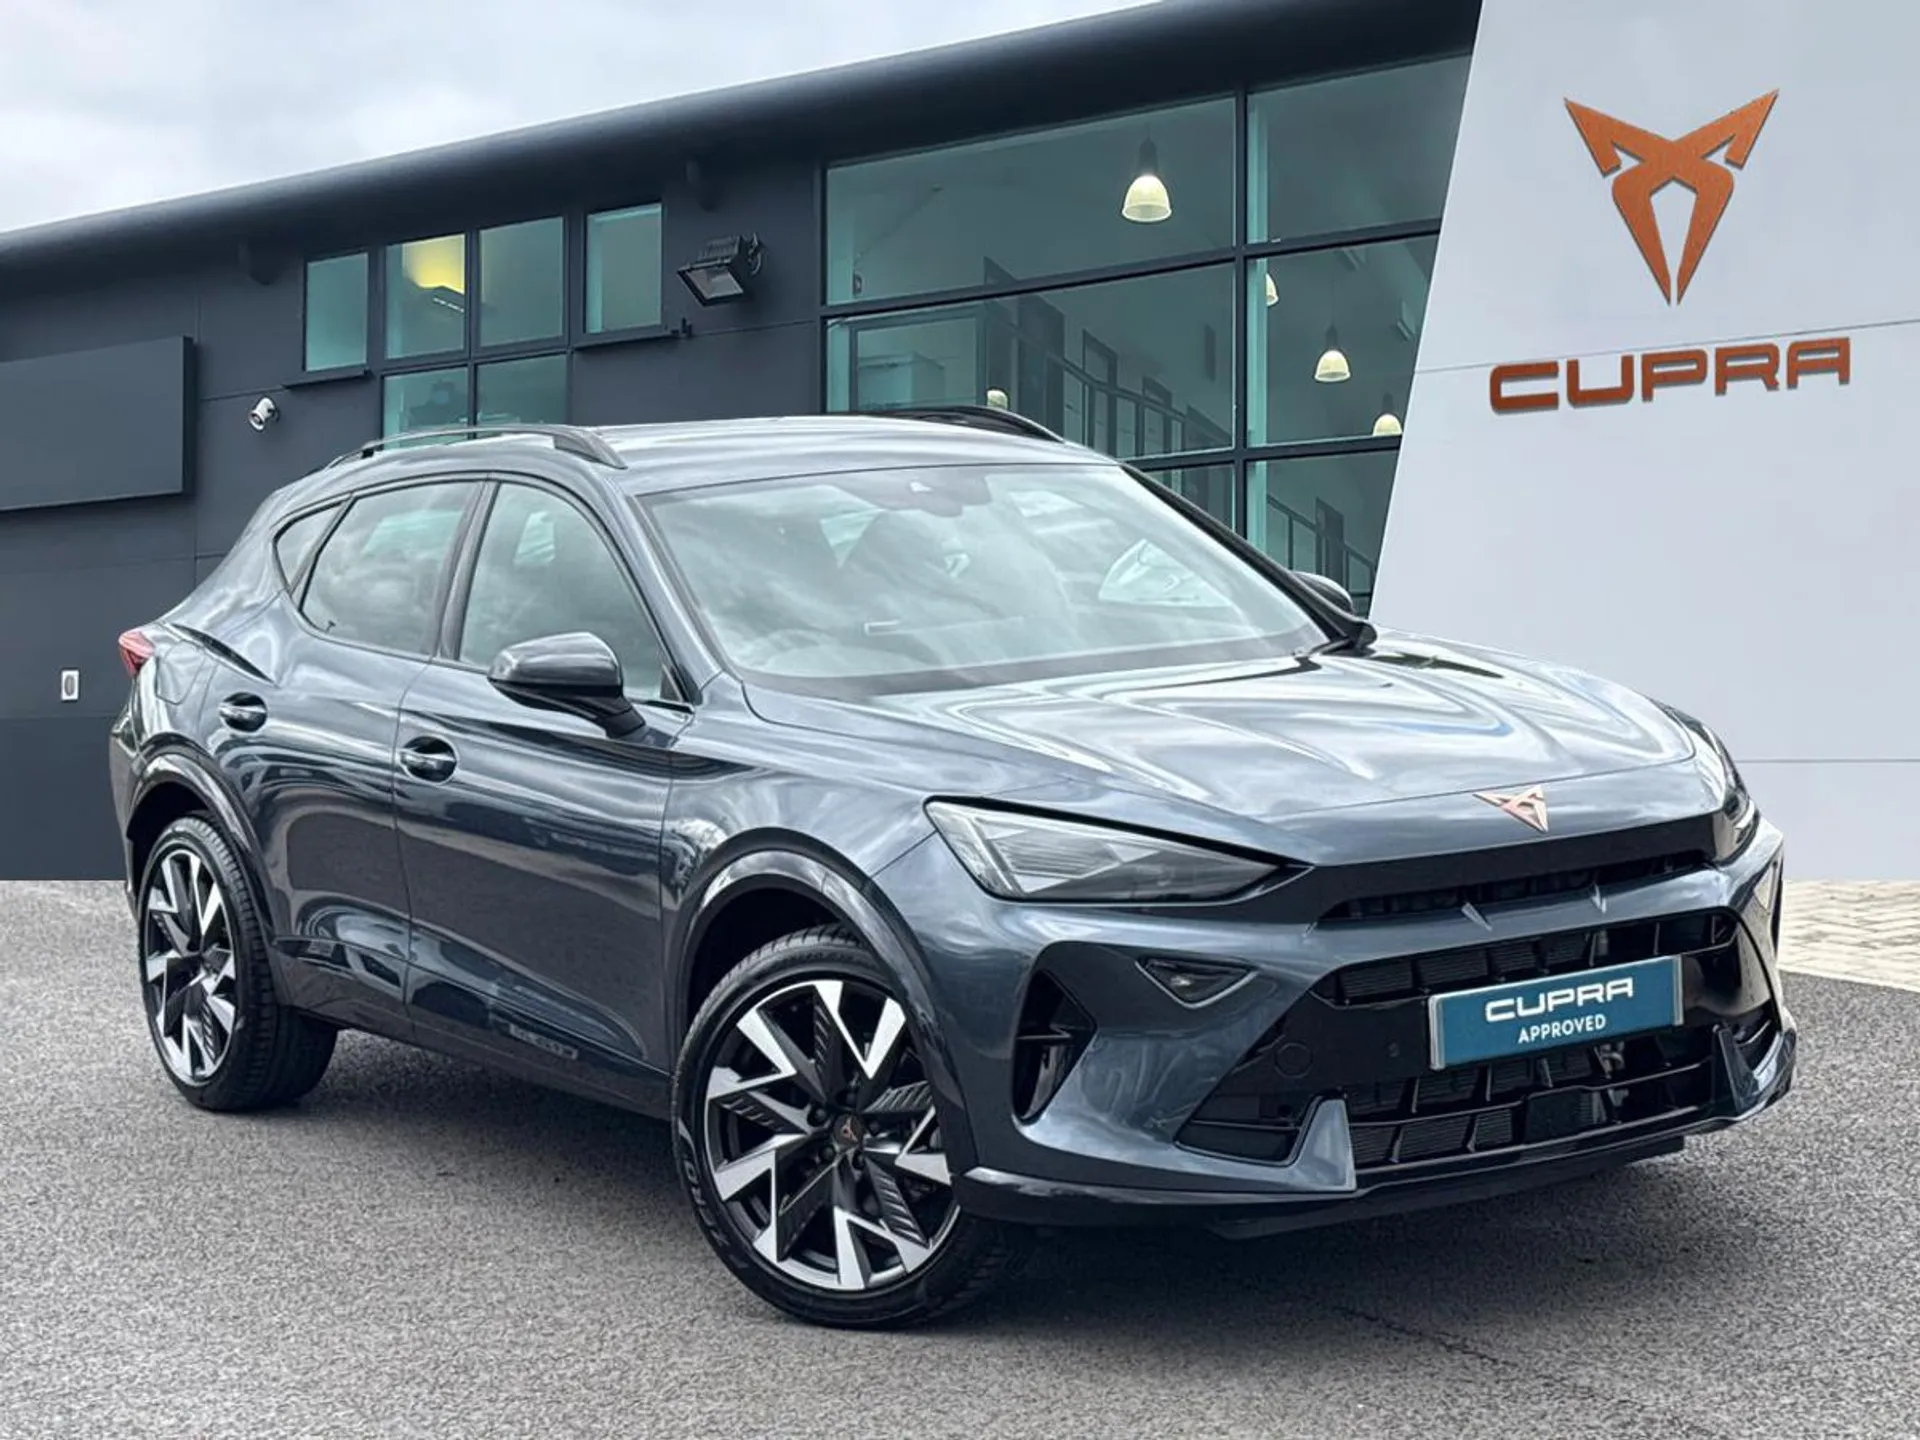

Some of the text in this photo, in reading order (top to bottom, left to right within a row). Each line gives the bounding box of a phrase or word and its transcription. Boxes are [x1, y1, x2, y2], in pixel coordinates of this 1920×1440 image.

[1490, 337, 1850, 415] CUPRA
[1485, 977, 1634, 1022] CUPRA
[1518, 1014, 1606, 1044] APPROVED
